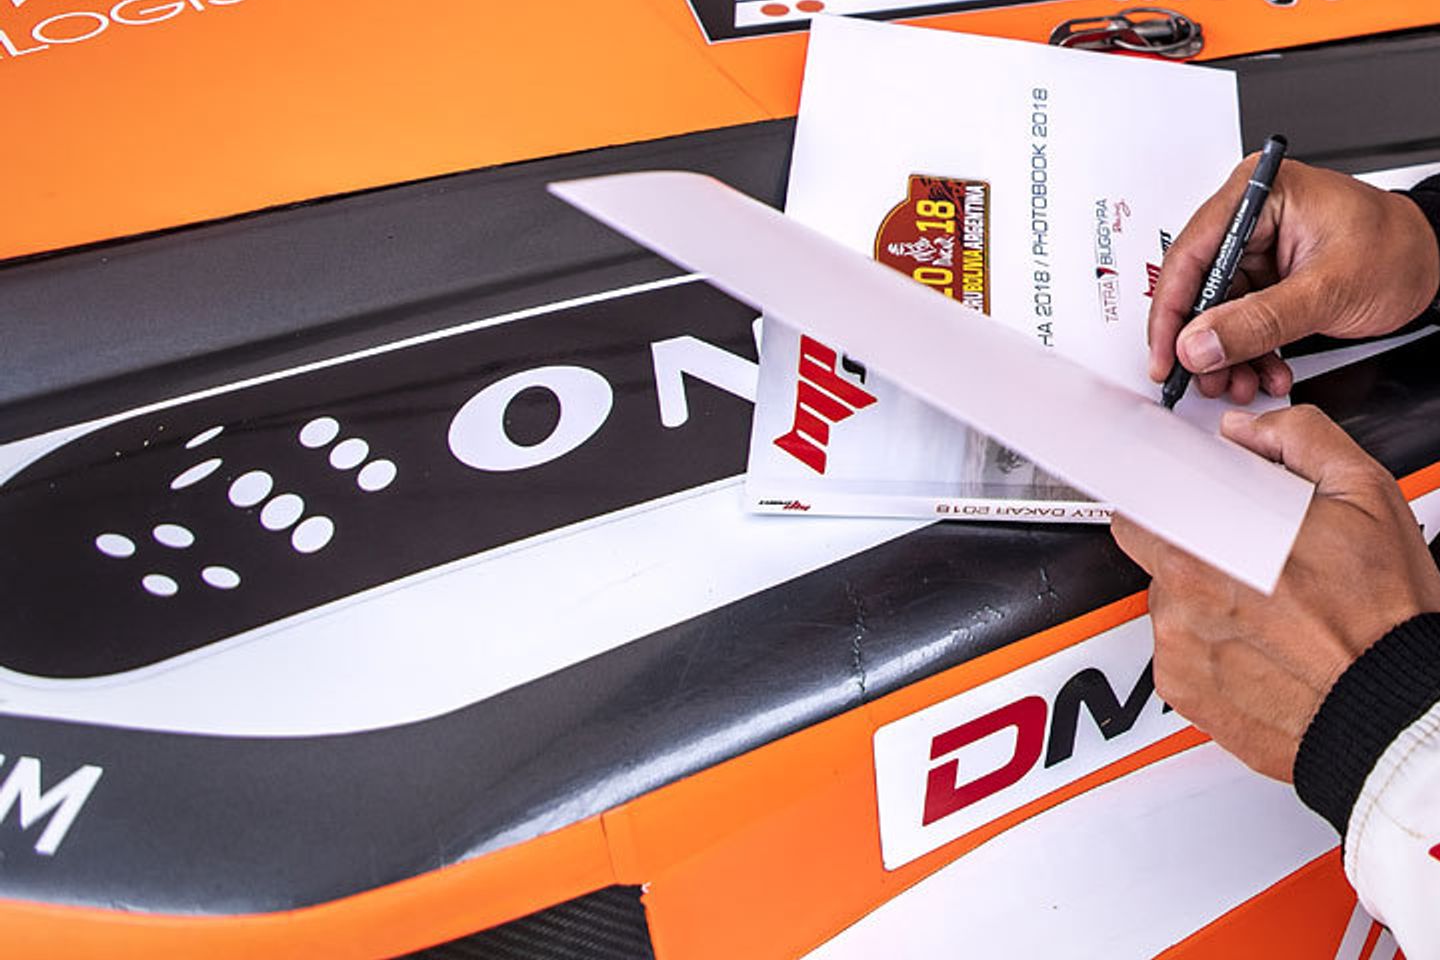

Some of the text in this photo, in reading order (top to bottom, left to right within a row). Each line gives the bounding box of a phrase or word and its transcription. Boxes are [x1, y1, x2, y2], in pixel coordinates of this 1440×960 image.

[1031, 87, 1048, 138] 2018
[1031, 143, 1048, 256] PHOTOBOOK
[1033, 266, 1052, 317] 2018
[1102, 280, 1119, 323] TATRA
[1037, 321, 1054, 347] HA
